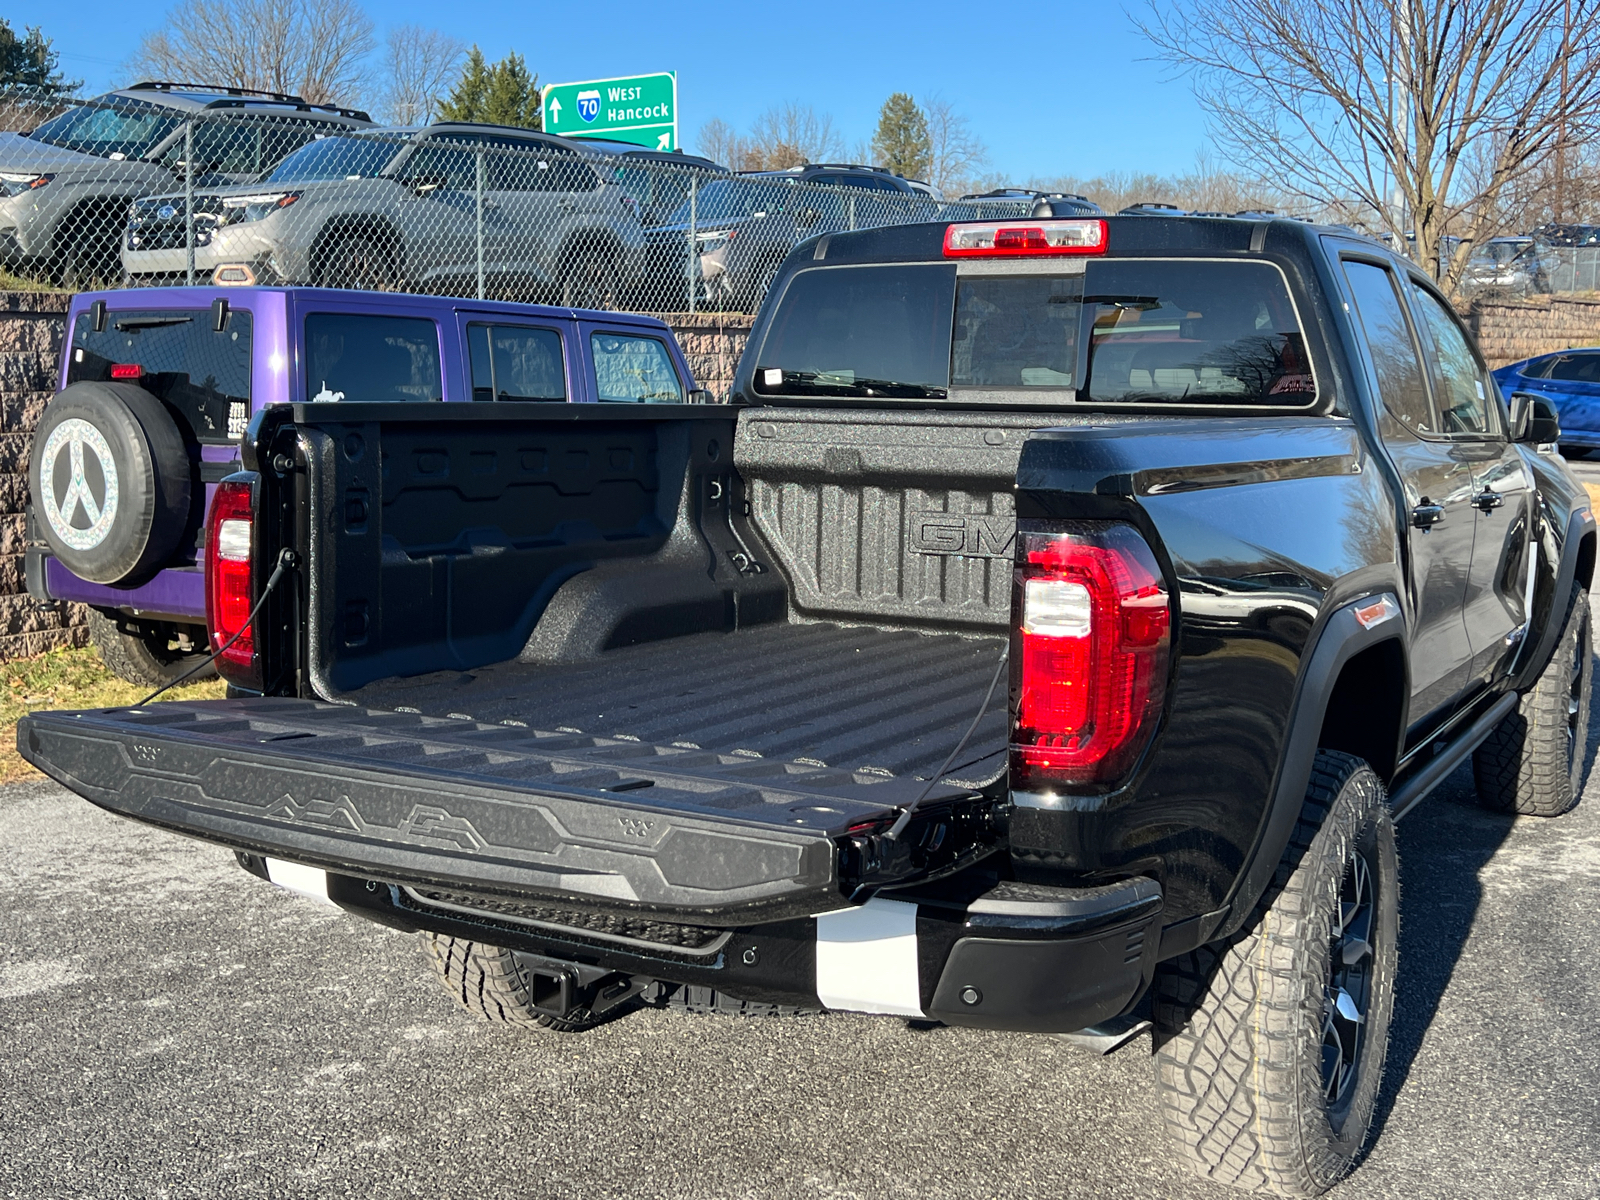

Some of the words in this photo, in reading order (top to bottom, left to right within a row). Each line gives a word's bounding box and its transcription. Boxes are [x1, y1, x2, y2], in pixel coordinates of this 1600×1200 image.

[607, 87, 641, 102] WEST
[580, 99, 598, 116] 70
[607, 102, 669, 122] Hancock
[910, 514, 1017, 557] GM
